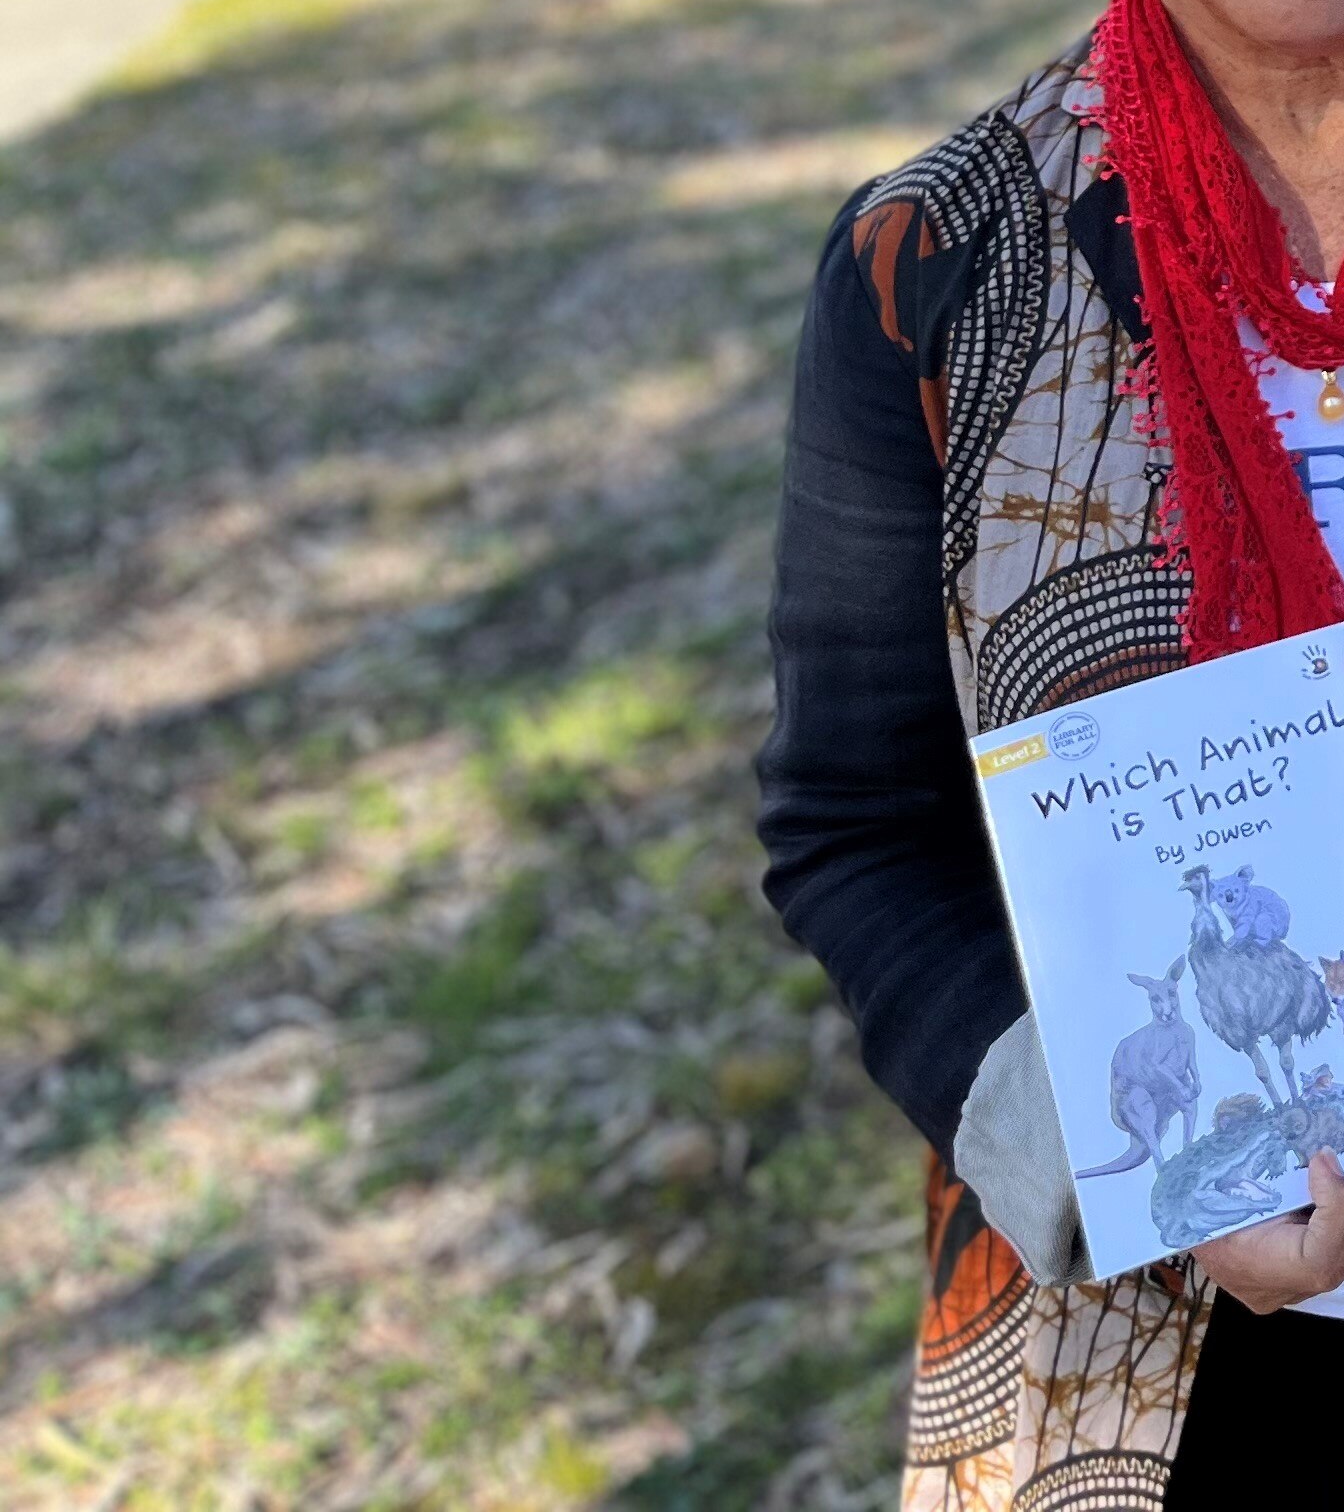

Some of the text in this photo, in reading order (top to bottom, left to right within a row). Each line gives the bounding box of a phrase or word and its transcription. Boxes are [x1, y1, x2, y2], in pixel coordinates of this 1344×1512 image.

[993, 745, 1029, 767] Level
[1031, 742, 1041, 755] 2
[1031, 750, 1179, 819] Which
[1110, 755, 1292, 842] is That?
[1154, 845, 1185, 865] By
